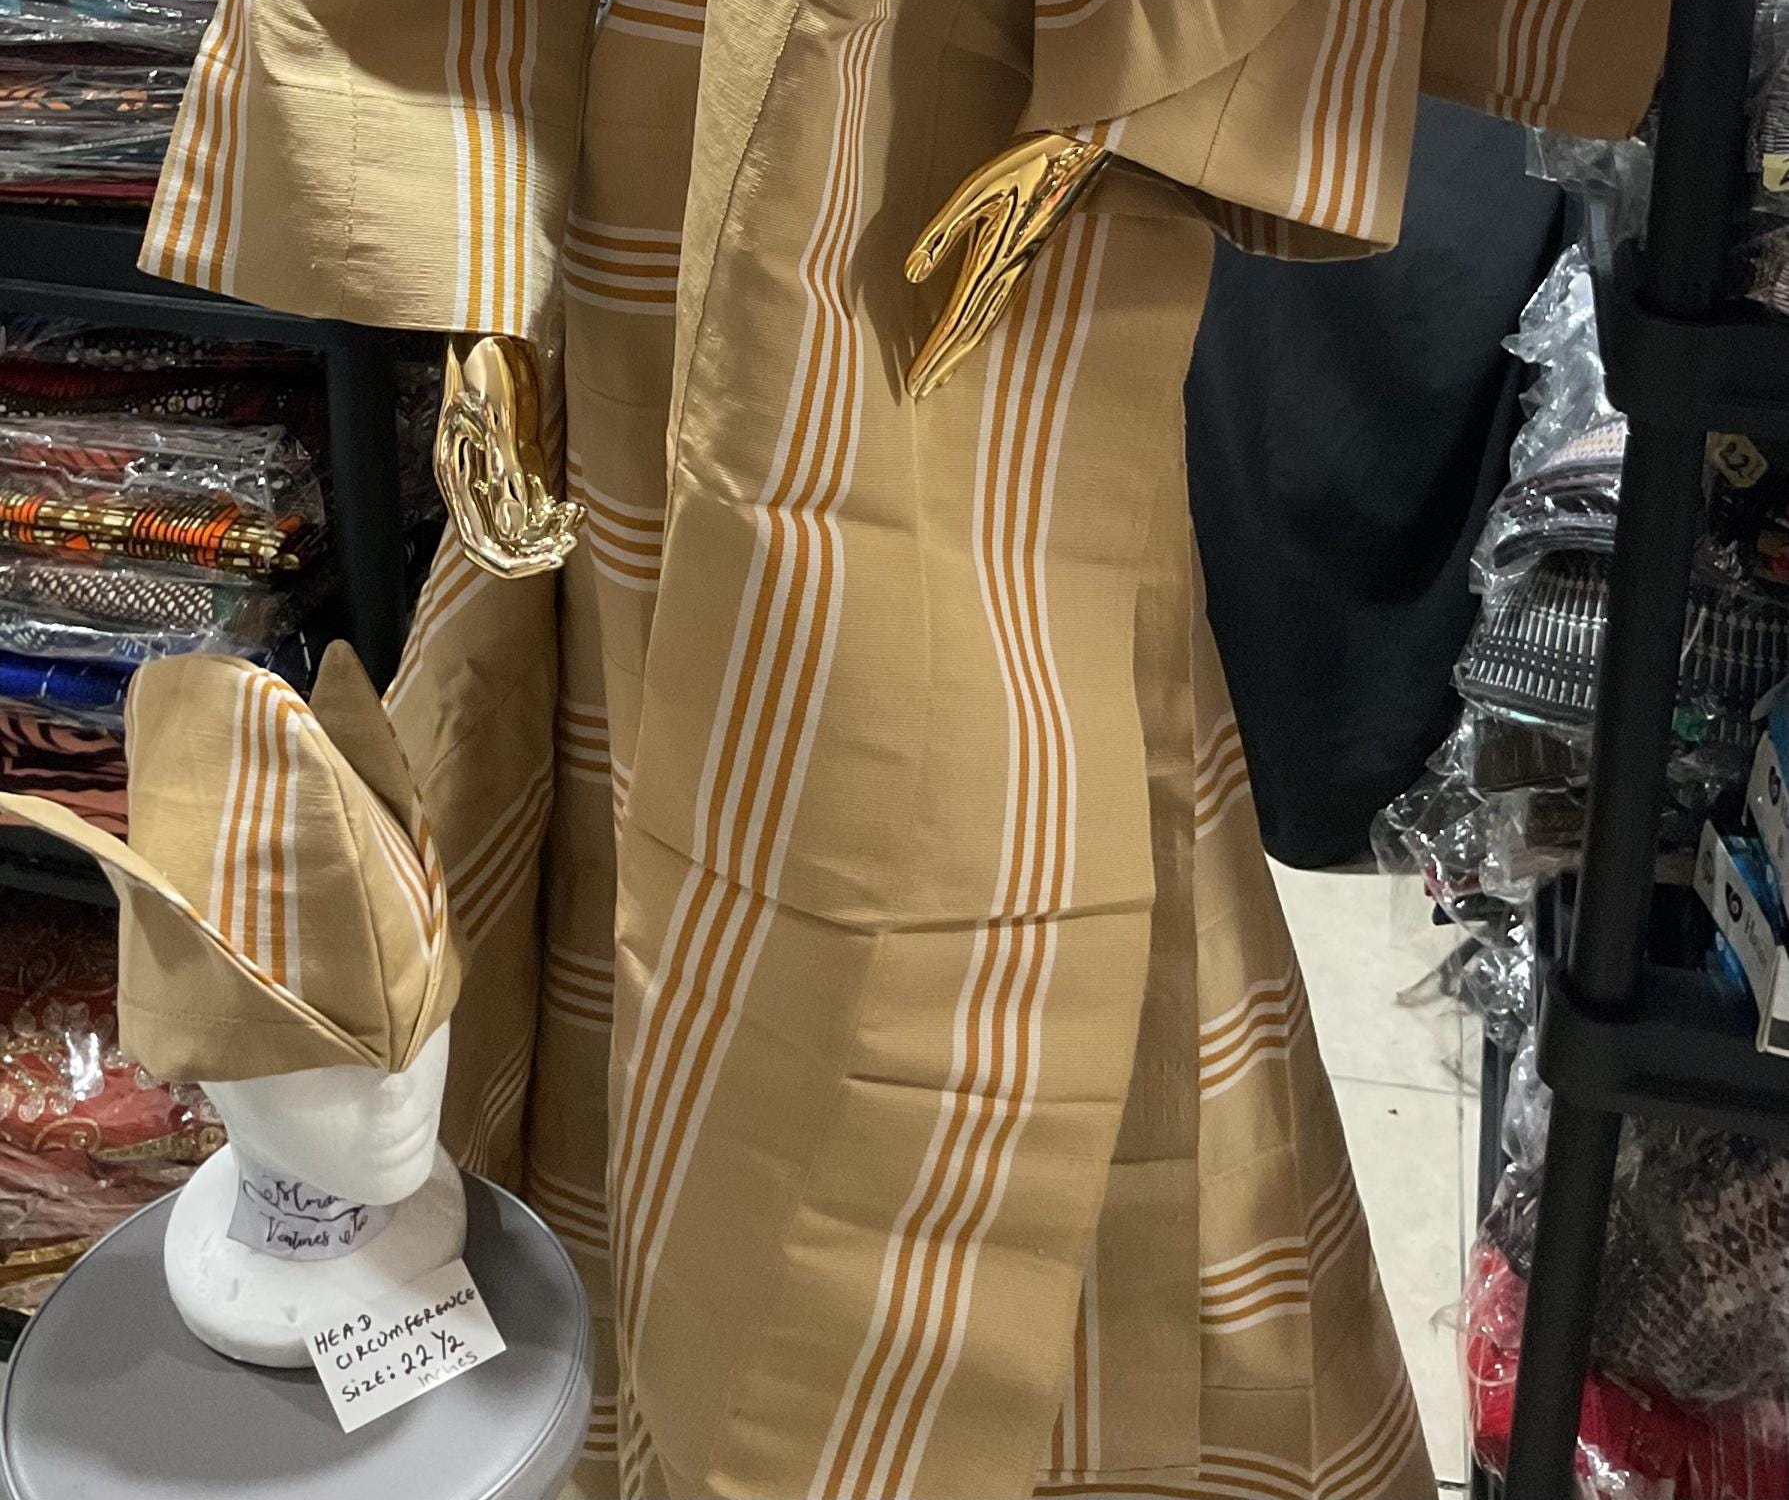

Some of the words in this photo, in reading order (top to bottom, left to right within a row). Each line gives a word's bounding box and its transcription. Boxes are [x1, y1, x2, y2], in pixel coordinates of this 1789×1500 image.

[313, 1313, 372, 1355] HEAD
[335, 1287, 476, 1370] CIRCUMFERENCE
[401, 1343, 434, 1375] 22
